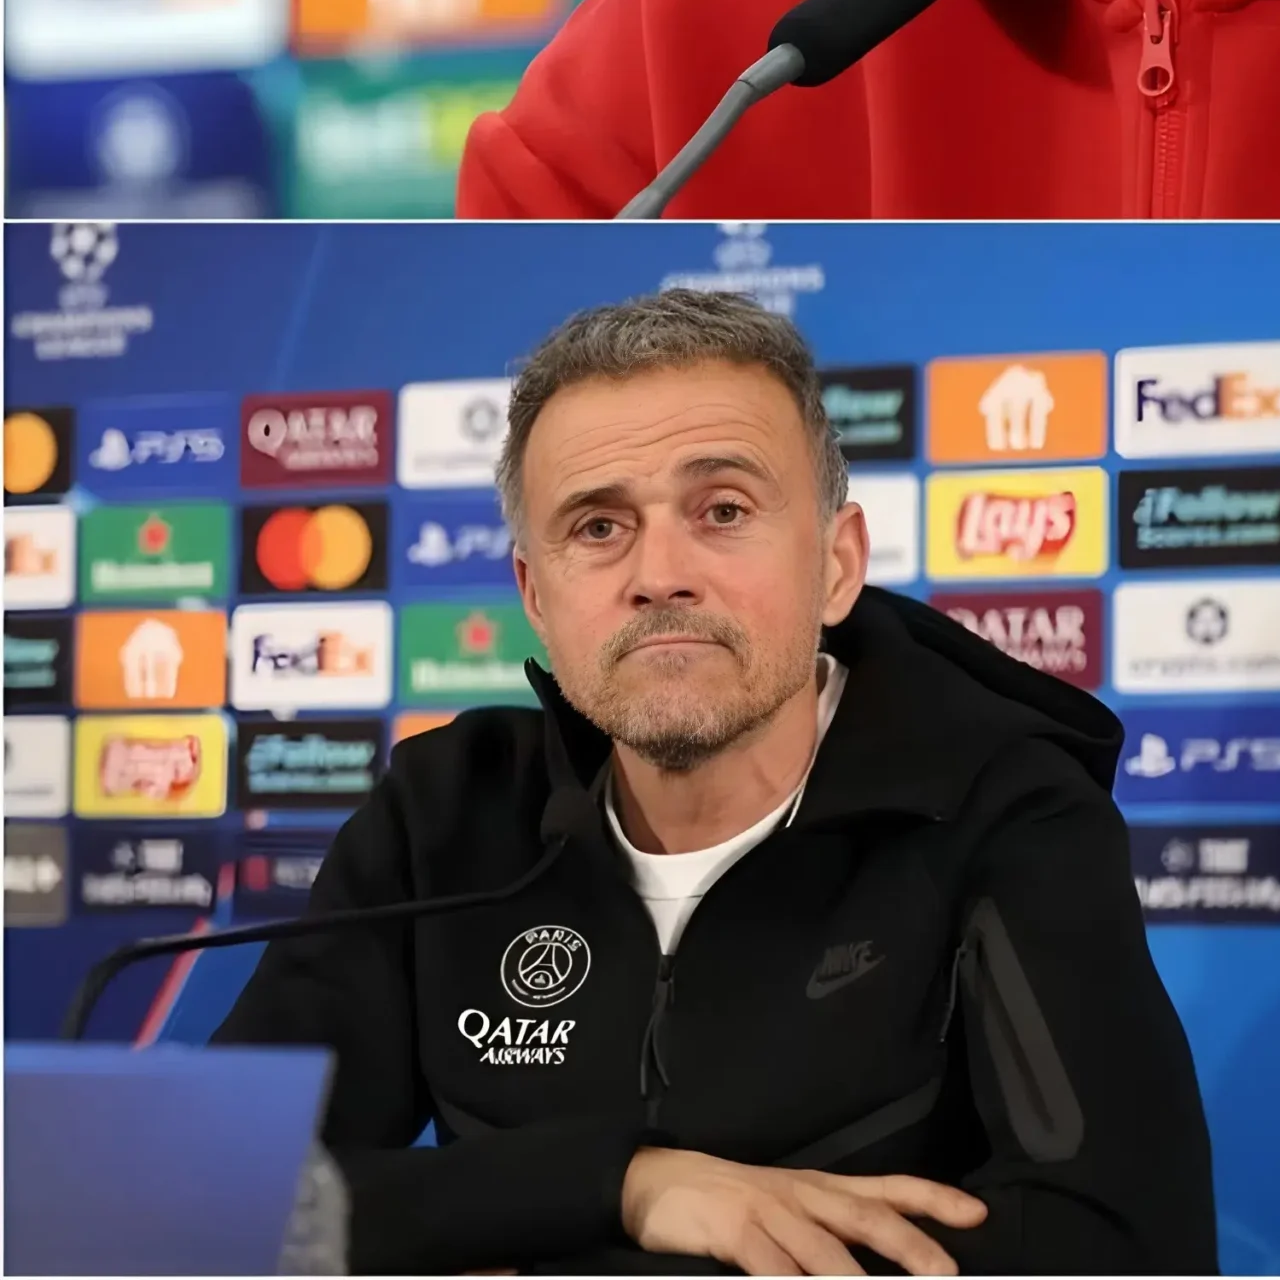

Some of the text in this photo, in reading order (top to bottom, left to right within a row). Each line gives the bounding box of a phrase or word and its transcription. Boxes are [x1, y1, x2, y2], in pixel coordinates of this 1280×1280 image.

[252, 631, 374, 677] FedEx
[525, 930, 582, 952] PARIS
[458, 1009, 576, 1048] QATAR
